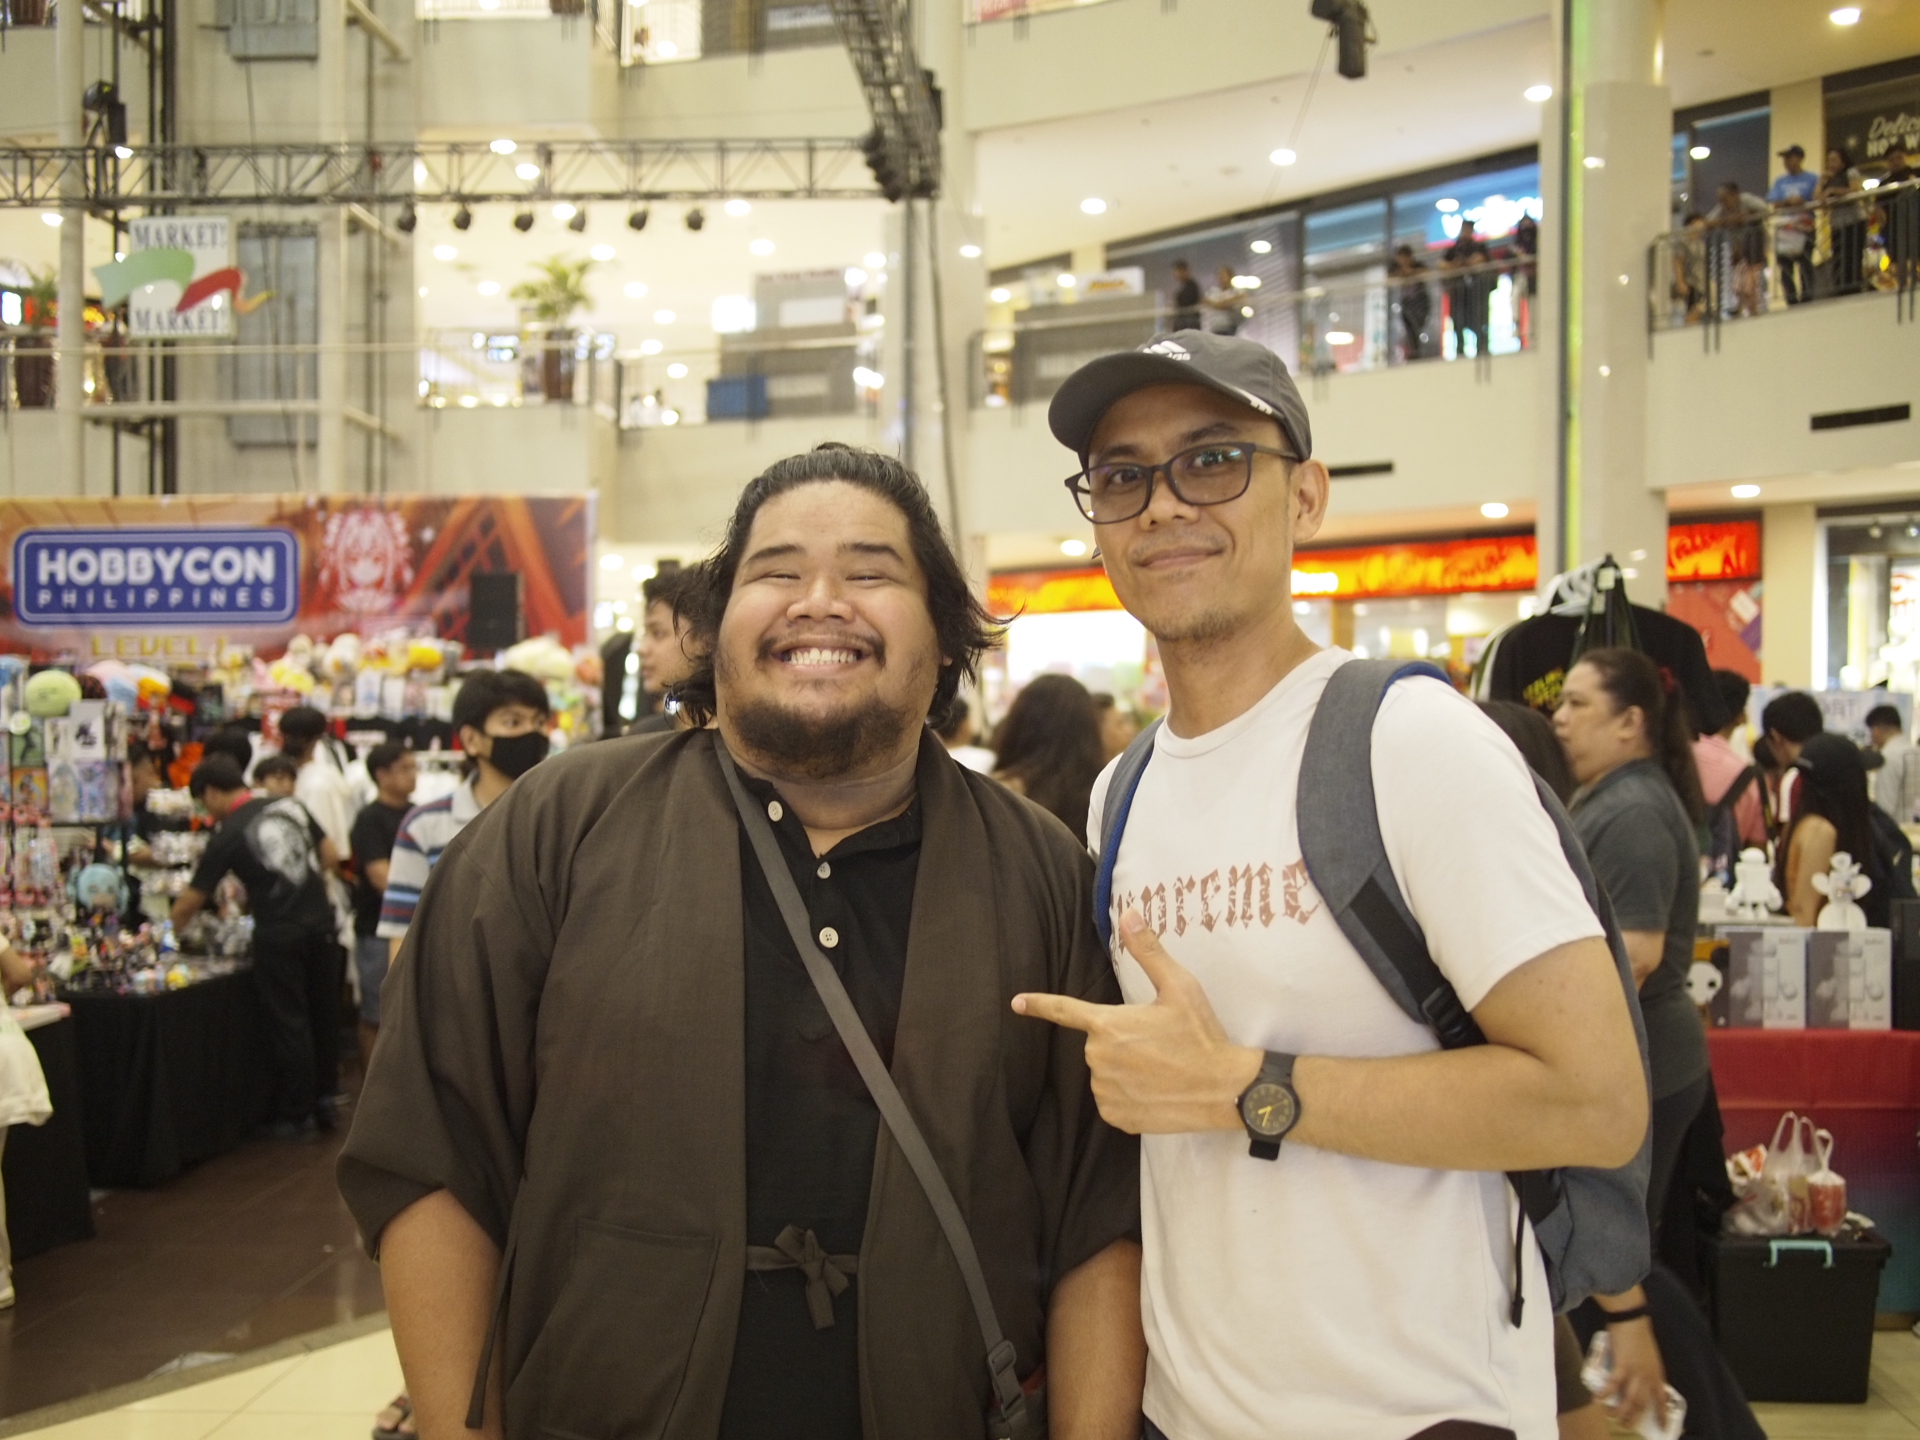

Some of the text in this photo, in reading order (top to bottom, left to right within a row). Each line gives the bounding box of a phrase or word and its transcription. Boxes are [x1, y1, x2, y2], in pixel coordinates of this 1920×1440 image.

[37, 546, 276, 586] HOBBYCON
[37, 587, 276, 609] PHILIPPINES
[1109, 857, 1322, 955] upreme
